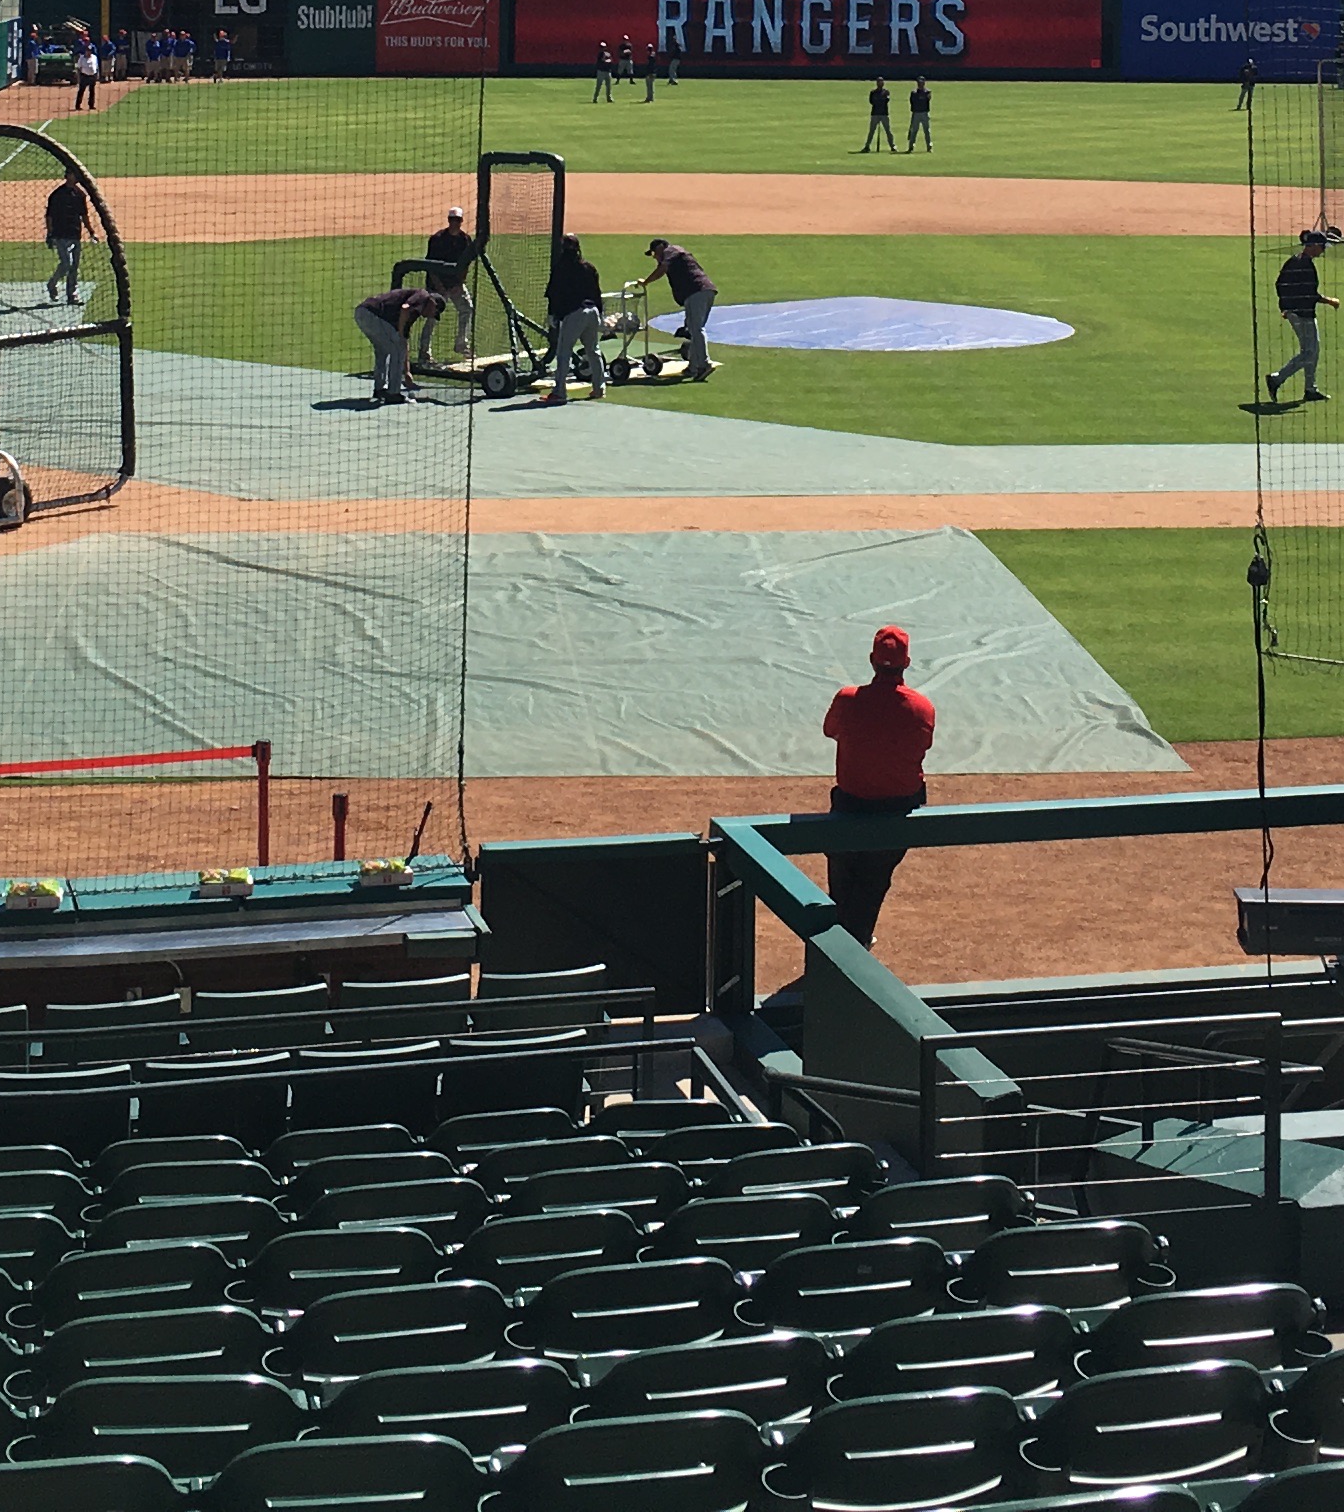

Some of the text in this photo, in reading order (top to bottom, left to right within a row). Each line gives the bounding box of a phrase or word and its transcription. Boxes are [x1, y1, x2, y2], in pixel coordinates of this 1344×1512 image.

[298, 4, 373, 29] StubHub!
[384, 36, 410, 47] THIS
[444, 36, 466, 48] FOR
[1141, 16, 1299, 44] Southwest
